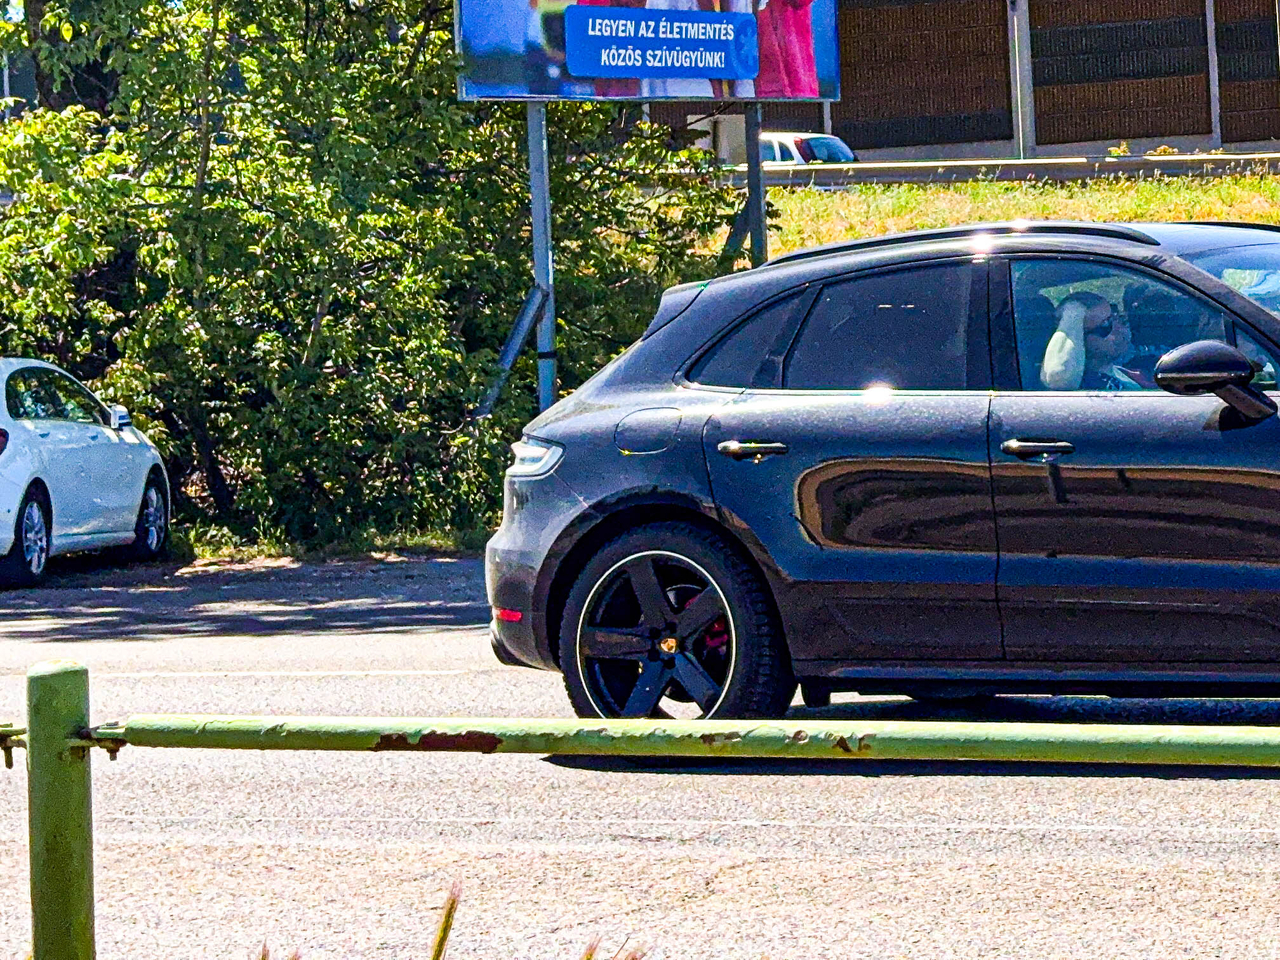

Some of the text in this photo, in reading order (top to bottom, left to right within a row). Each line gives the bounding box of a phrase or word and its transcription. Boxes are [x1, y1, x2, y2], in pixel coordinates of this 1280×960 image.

[588, 17, 734, 41] LEGYEN AZ ÉLETMENTÉS
[600, 44, 725, 68] KÖZÖS SZÍVÜGYÜNK!
